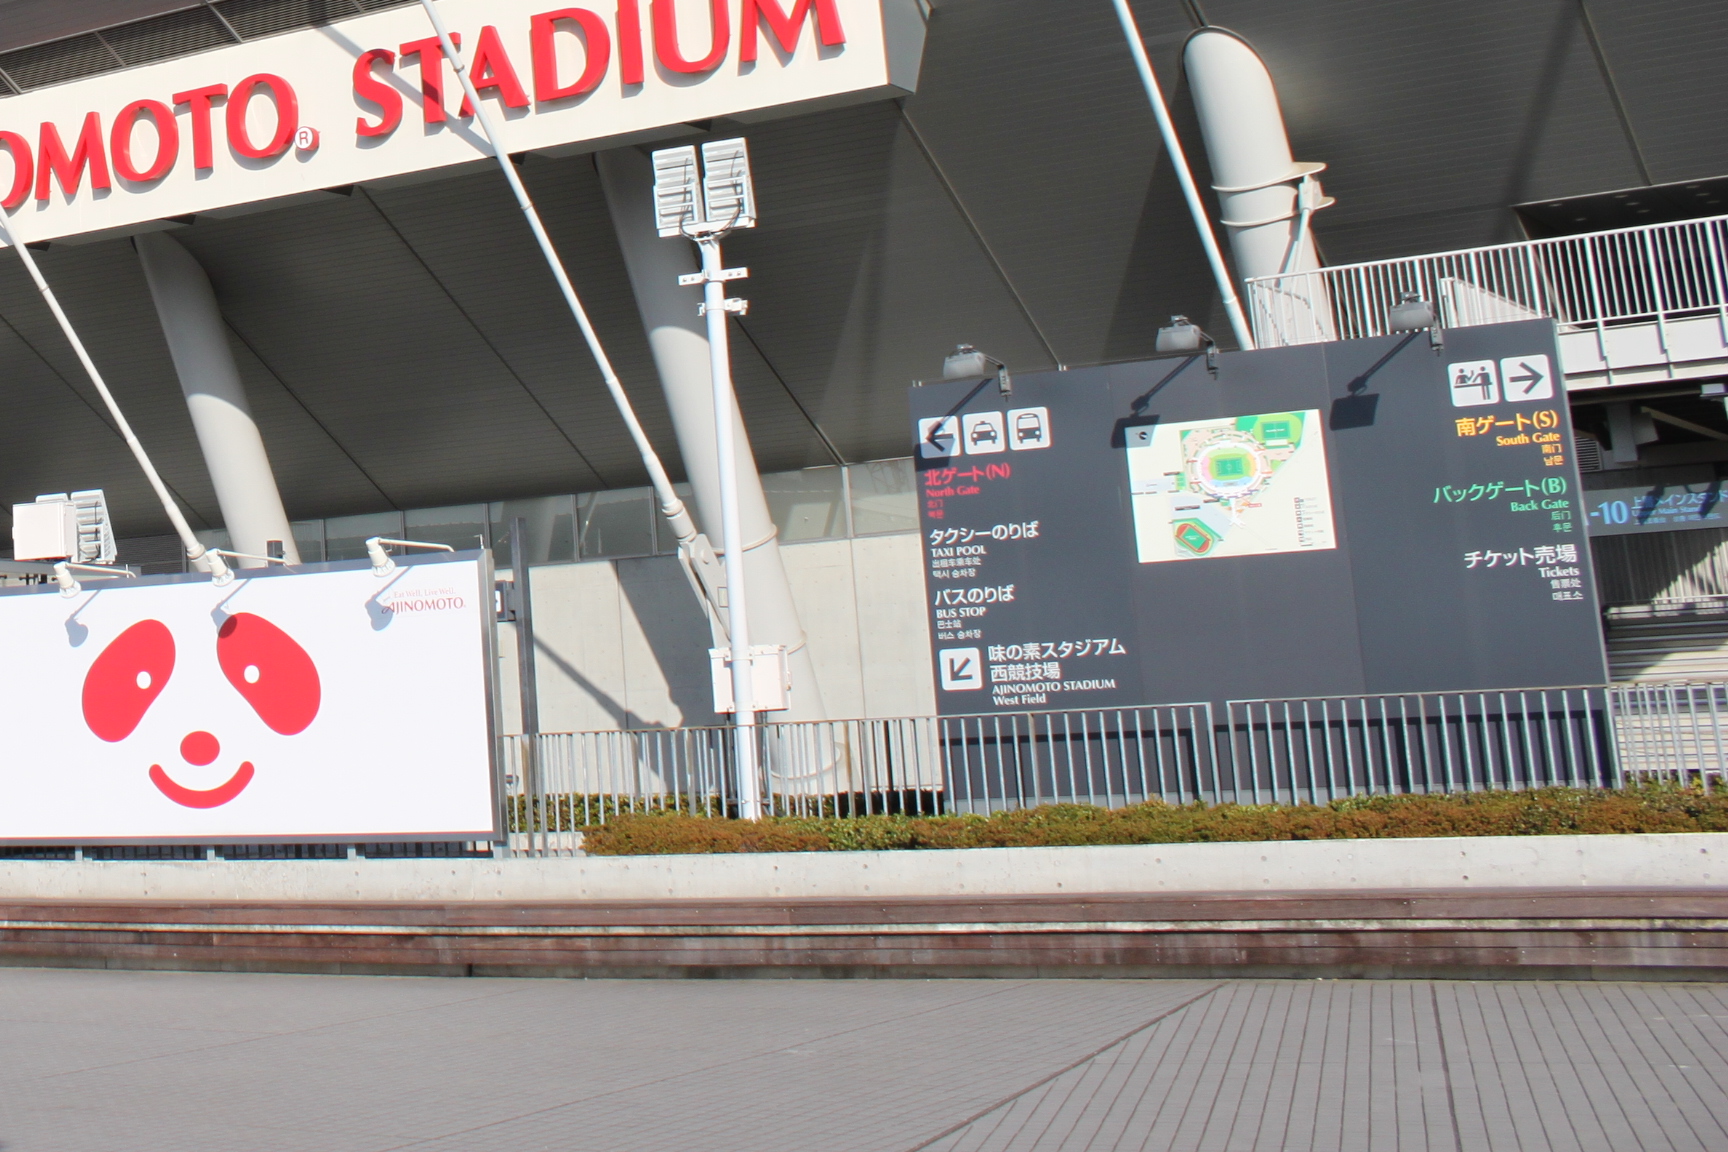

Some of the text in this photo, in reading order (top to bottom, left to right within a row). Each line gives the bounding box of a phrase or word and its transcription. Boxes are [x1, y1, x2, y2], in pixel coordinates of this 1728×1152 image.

[1455, 410, 1558, 437] 南ゲート(S)
[1496, 432, 1560, 446] South Gate
[924, 462, 1011, 486] 北ゲート(N)
[926, 485, 980, 498] North Gate
[1433, 476, 1567, 503] バックゲート(B)
[1511, 498, 1570, 512] Back Gate
[1551, 510, 1571, 521] 后门
[929, 521, 1039, 545] タクシーのりば
[931, 545, 987, 557] TAXI POOL
[1464, 543, 1578, 568] チケット売場
[1538, 565, 1580, 578] Tickets
[934, 584, 1015, 606] バスのりば
[936, 606, 987, 618] BUS STOP
[988, 637, 1127, 662] 味の素スタジアム
[989, 661, 1061, 683] 西競技場
[992, 678, 1116, 695] AJINOMOTO STADIUM
[992, 693, 1046, 706] West Field
